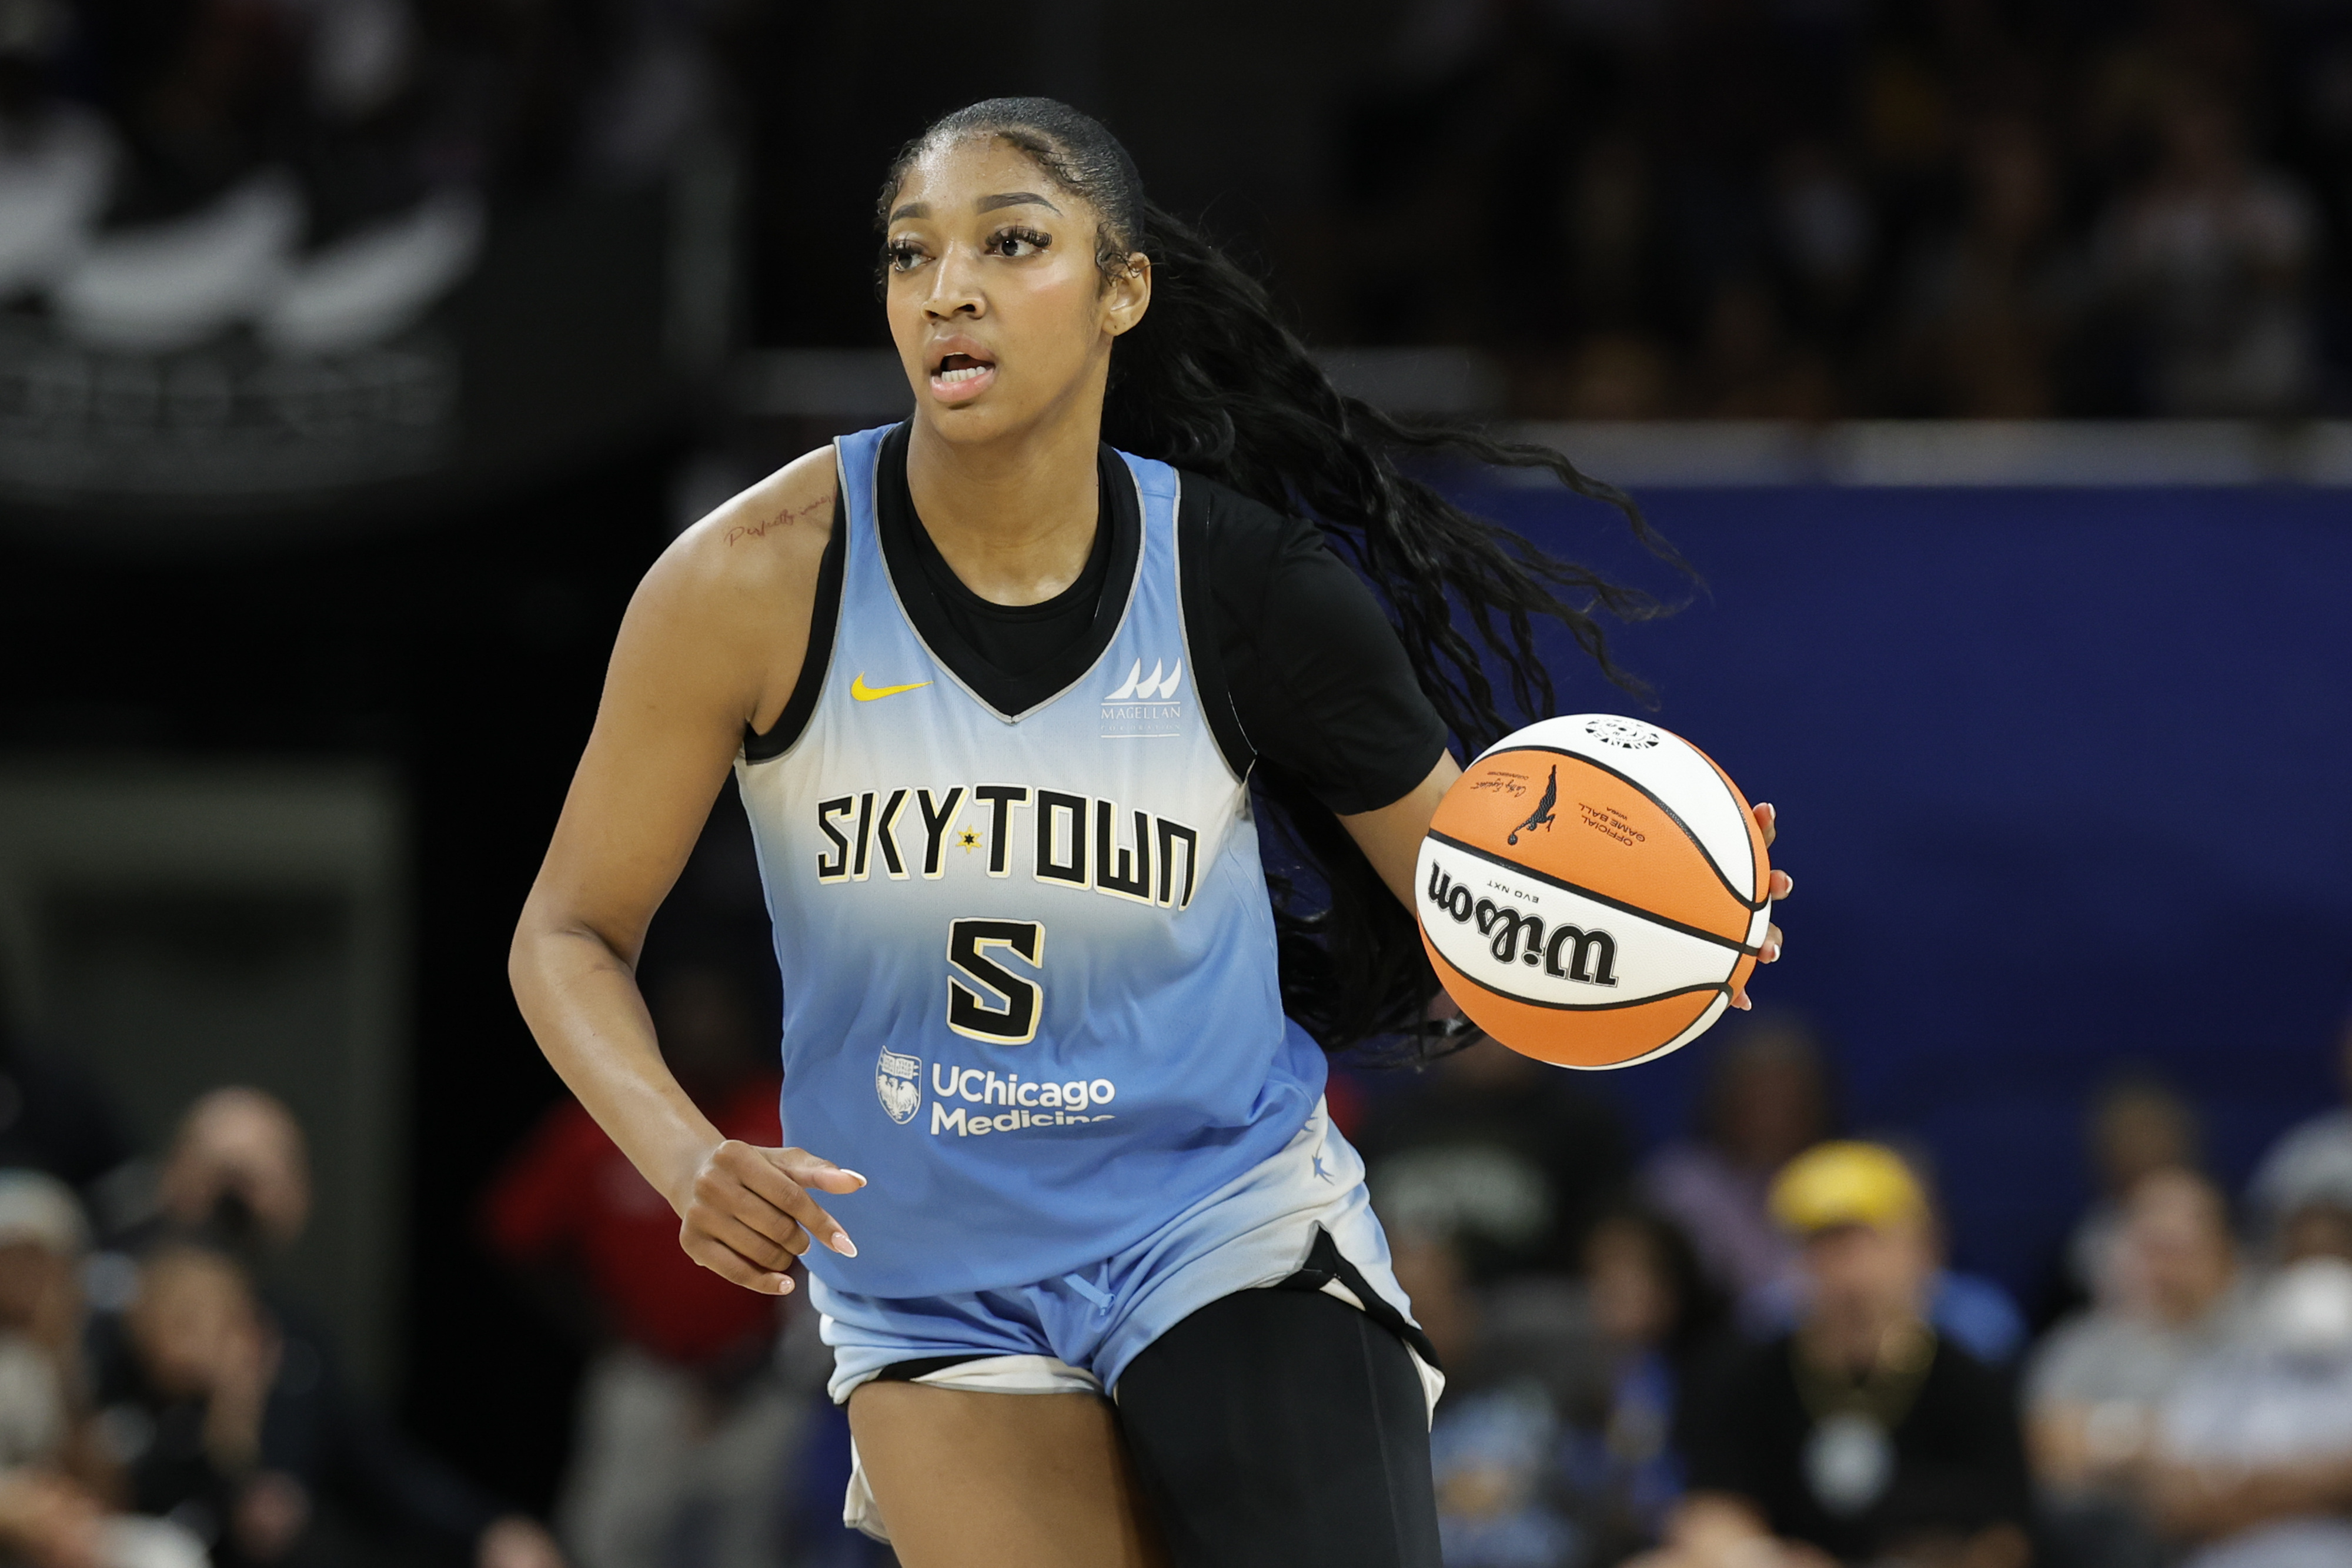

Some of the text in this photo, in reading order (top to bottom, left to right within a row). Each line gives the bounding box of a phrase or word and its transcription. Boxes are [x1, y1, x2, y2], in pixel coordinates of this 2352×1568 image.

[1101, 707, 1181, 720] MAGELLAN
[1579, 802, 1645, 842] GAME BALL
[1581, 815, 1633, 846] OFFICIAL
[1486, 880, 1539, 904] EVO NXT
[1428, 859, 1619, 988] Wilson
[932, 1063, 1116, 1112] UChicago
